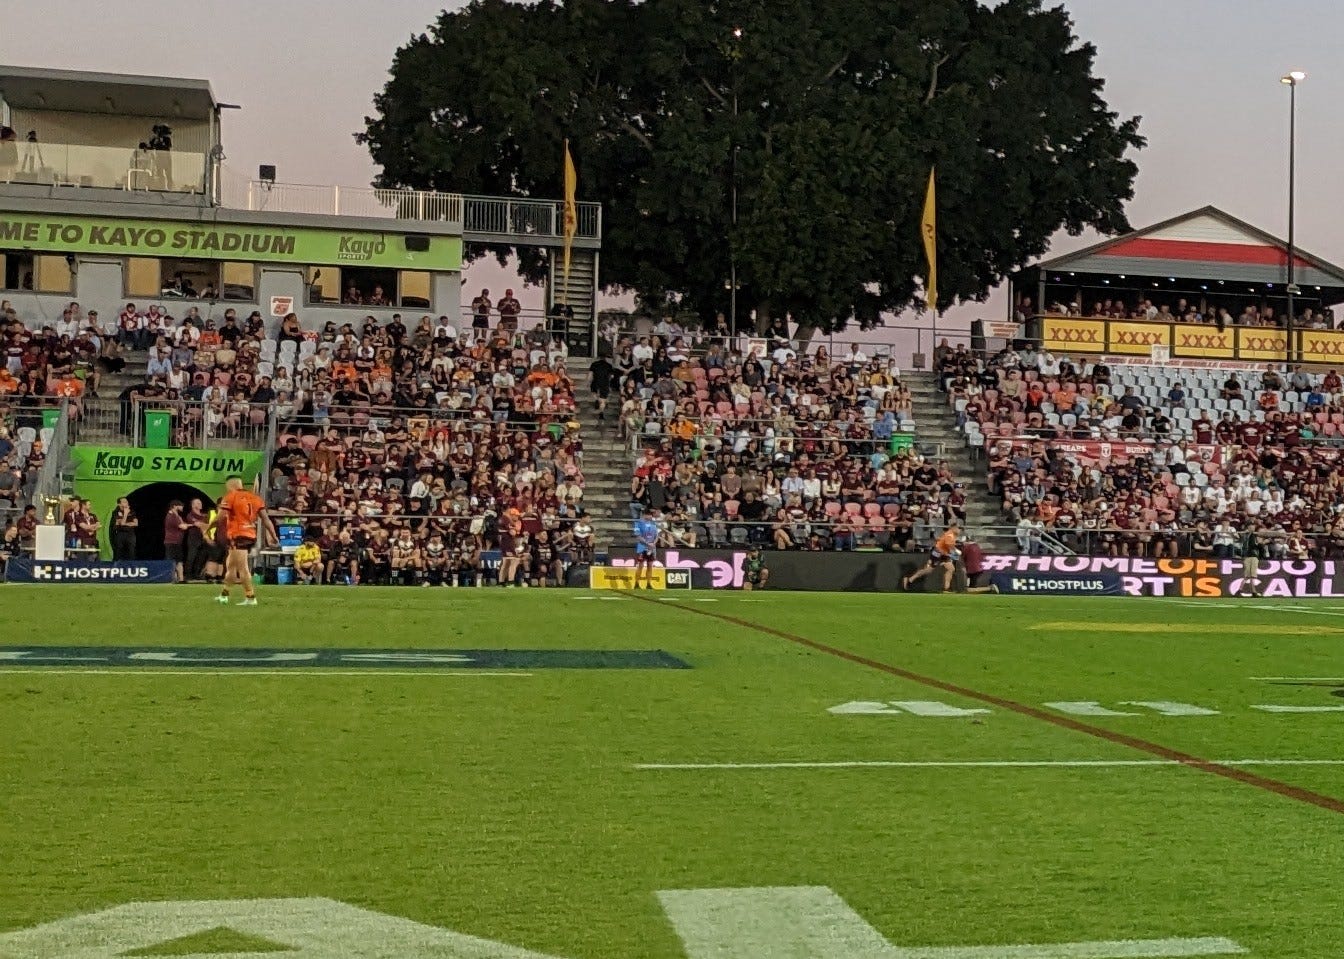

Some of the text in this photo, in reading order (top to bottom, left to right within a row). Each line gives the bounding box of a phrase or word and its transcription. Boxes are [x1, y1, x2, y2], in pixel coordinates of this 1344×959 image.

[47, 222, 84, 244] TO
[89, 226, 167, 248] KAYO
[171, 229, 296, 255] STADIUM
[338, 235, 386, 261] Kayo
[1050, 327, 1099, 342] XXXX
[1117, 330, 1163, 345] XXXX
[1182, 333, 1228, 349] XXXX
[95, 451, 244, 476] Kayo STADIUM
[66, 567, 149, 579] HOSTPLUS
[667, 572, 688, 584] CAT
[1037, 579, 1104, 590] HOSTPLUS
[1181, 577, 1222, 597] IS
